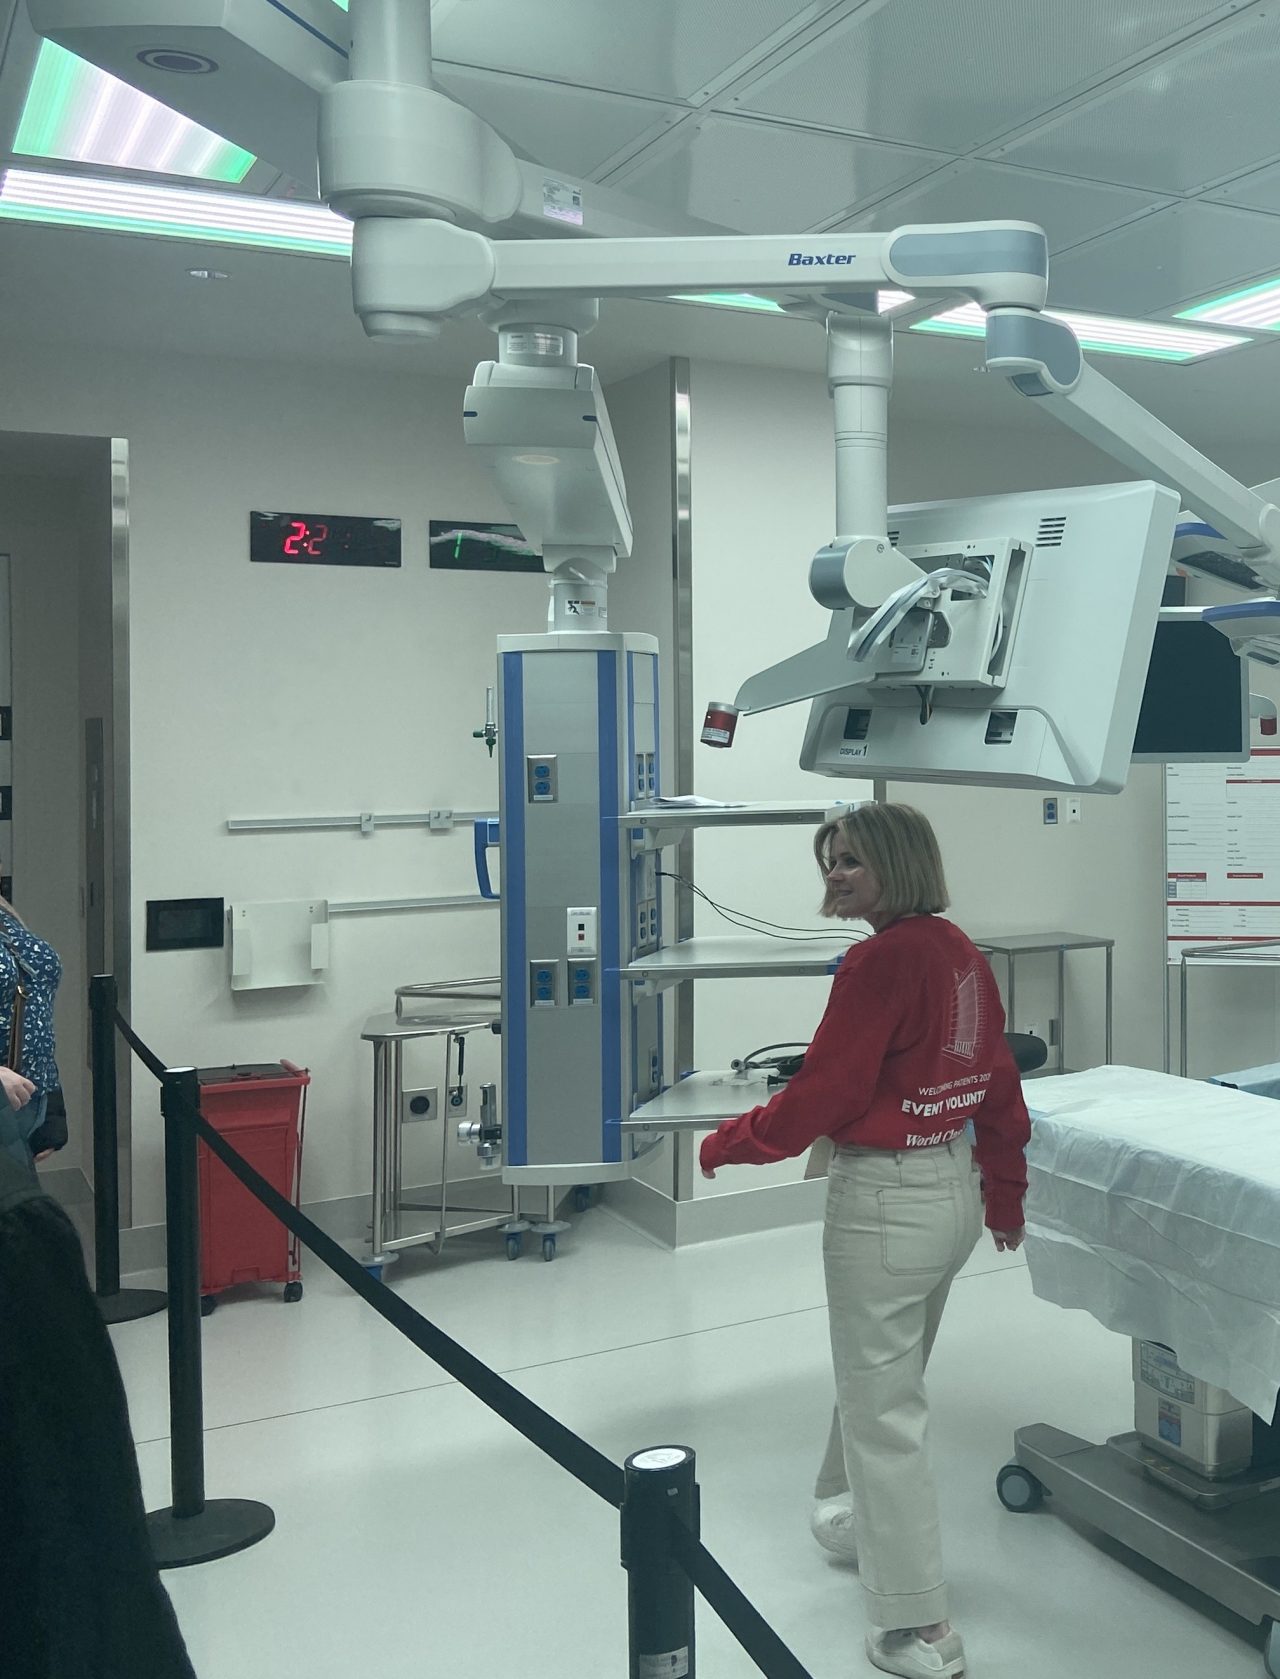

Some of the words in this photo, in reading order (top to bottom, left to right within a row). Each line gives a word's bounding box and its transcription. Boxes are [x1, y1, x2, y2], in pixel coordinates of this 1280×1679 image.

[787, 253, 856, 266] Baxter
[839, 747, 862, 756] DISPLAY
[863, 744, 868, 757] 1
[918, 1081, 954, 1096] WELCOMING
[953, 1075, 979, 1088] PATIENTS
[901, 1099, 943, 1117] EVENT
[945, 1090, 987, 1111] VOLUNT
[906, 1131, 943, 1147] World
